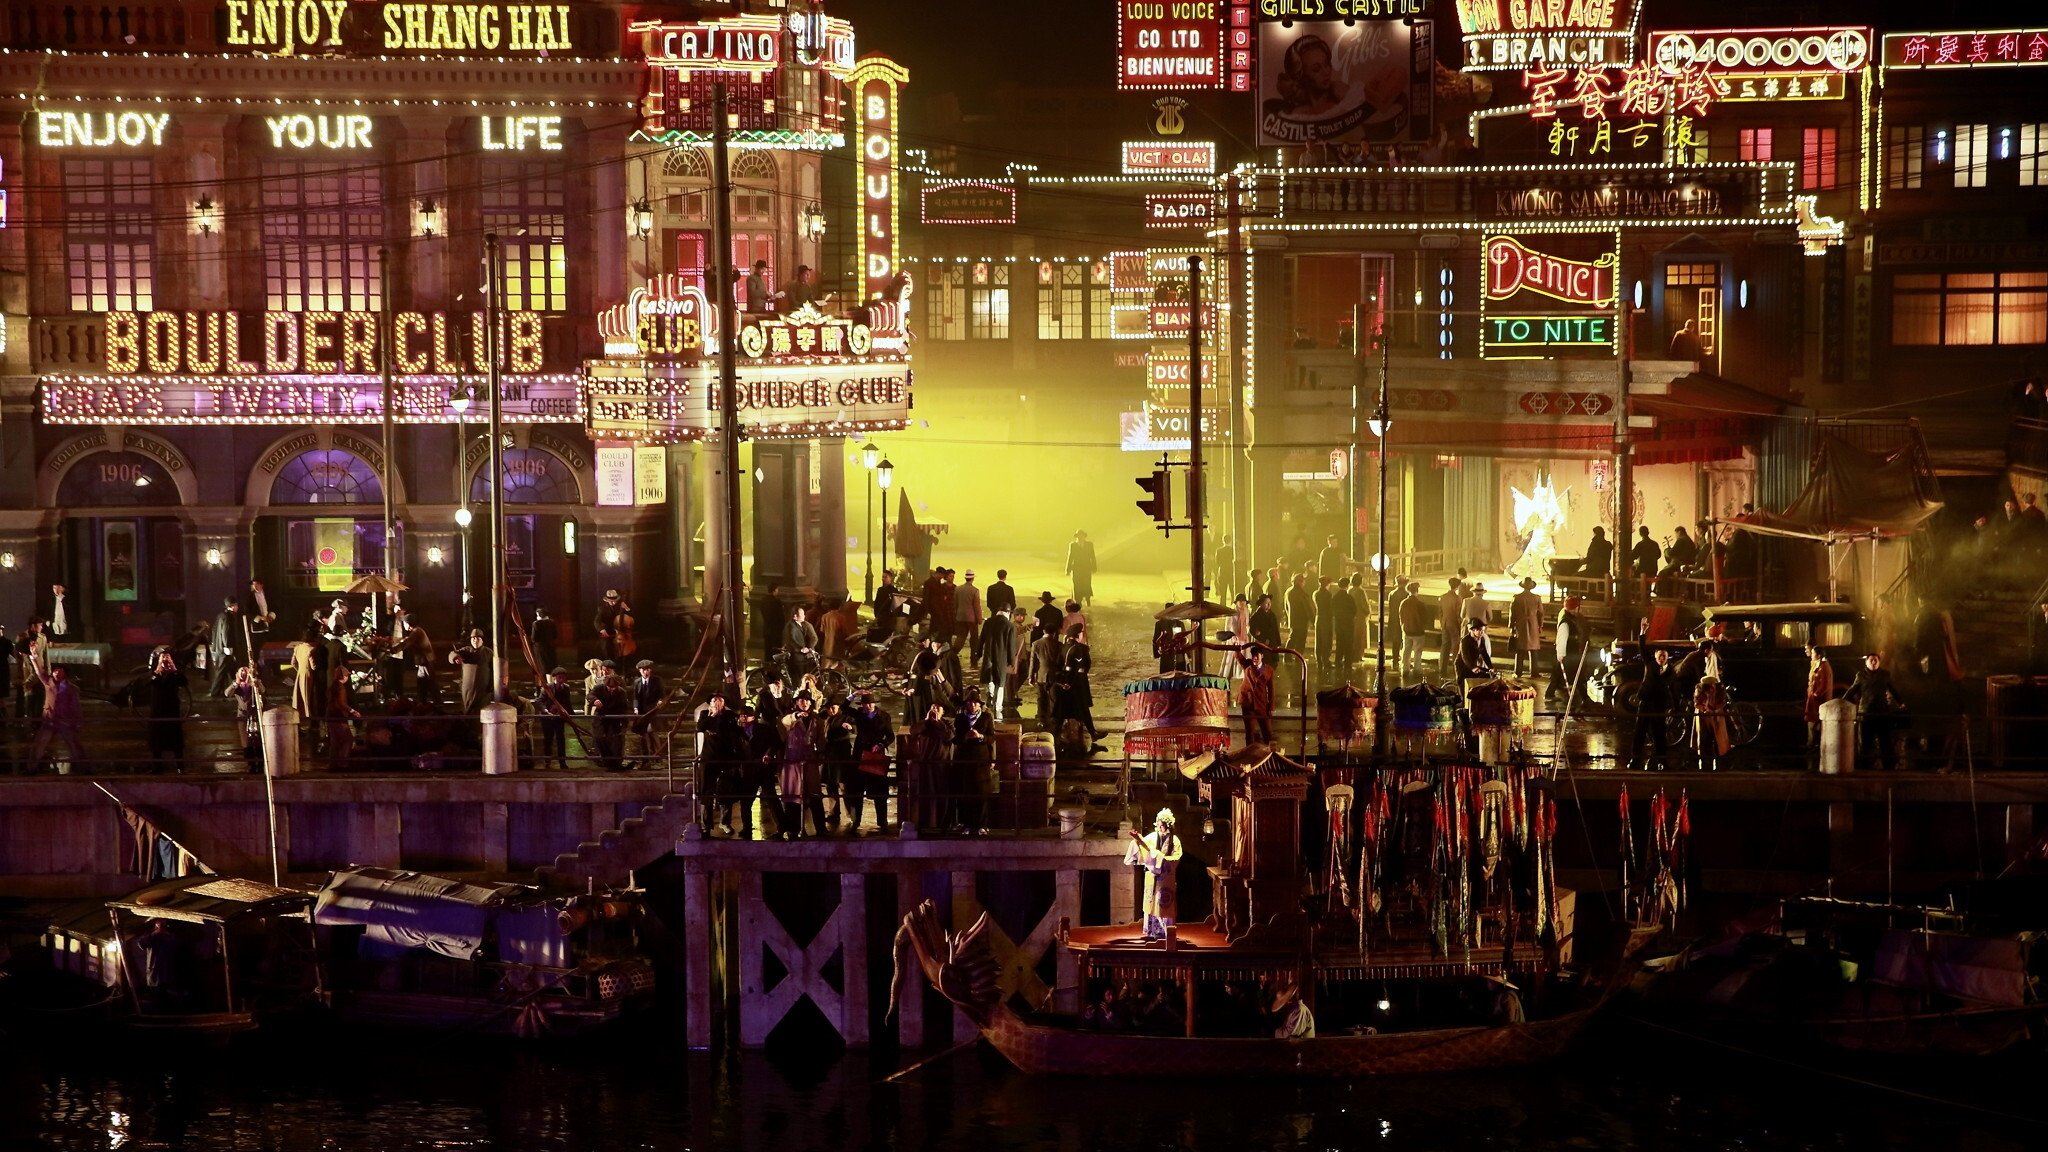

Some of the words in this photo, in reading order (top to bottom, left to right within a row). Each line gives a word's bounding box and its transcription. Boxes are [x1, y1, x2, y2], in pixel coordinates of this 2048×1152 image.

[1127, 3, 1164, 20] LOUD
[1511, 0, 1615, 29] GARAGE
[227, 0, 347, 55] ENJOY
[1236, 0, 1247, 89] TORE
[1492, 38, 1605, 64] BRANCH
[1695, 36, 1828, 67] 40000
[1127, 57, 1214, 76] BIENVENUE
[1152, 96, 1169, 109] LOUD
[1170, 96, 1190, 109] VOICE
[38, 111, 172, 147] ENJOY
[264, 114, 373, 148] YOUR
[481, 115, 562, 150] LIFE
[1263, 113, 1316, 140] CASTILE
[1318, 121, 1343, 136] TOILET
[1129, 151, 1208, 165] VICTROLAS
[1153, 203, 1206, 218] RADIO
[1496, 189, 1563, 216] KWONG
[1570, 189, 1619, 216] SANG
[1626, 189, 1681, 216] HONG
[1154, 257, 1206, 272] MUSIA
[638, 299, 694, 314] CASINO
[1155, 312, 1208, 325] PIANS
[106, 311, 377, 374] BOULDER
[396, 311, 543, 374] CLUB
[636, 315, 702, 354] CLUB
[1494, 319, 1530, 342] TO
[1544, 319, 1605, 342] NITE
[1156, 364, 1208, 380] DISCS
[208, 385, 358, 415] TWENTY
[839, 377, 904, 406] CLUB
[530, 398, 572, 413] COFFEE
[1156, 417, 1209, 432] VOIE
[50, 434, 107, 471] BOULDER
[125, 434, 181, 471] CASINO
[262, 434, 317, 472] BOULDER
[530, 431, 584, 468] CASINO
[99, 464, 142, 482] 1906
[508, 459, 546, 477] 1906
[641, 487, 663, 500] 1906
